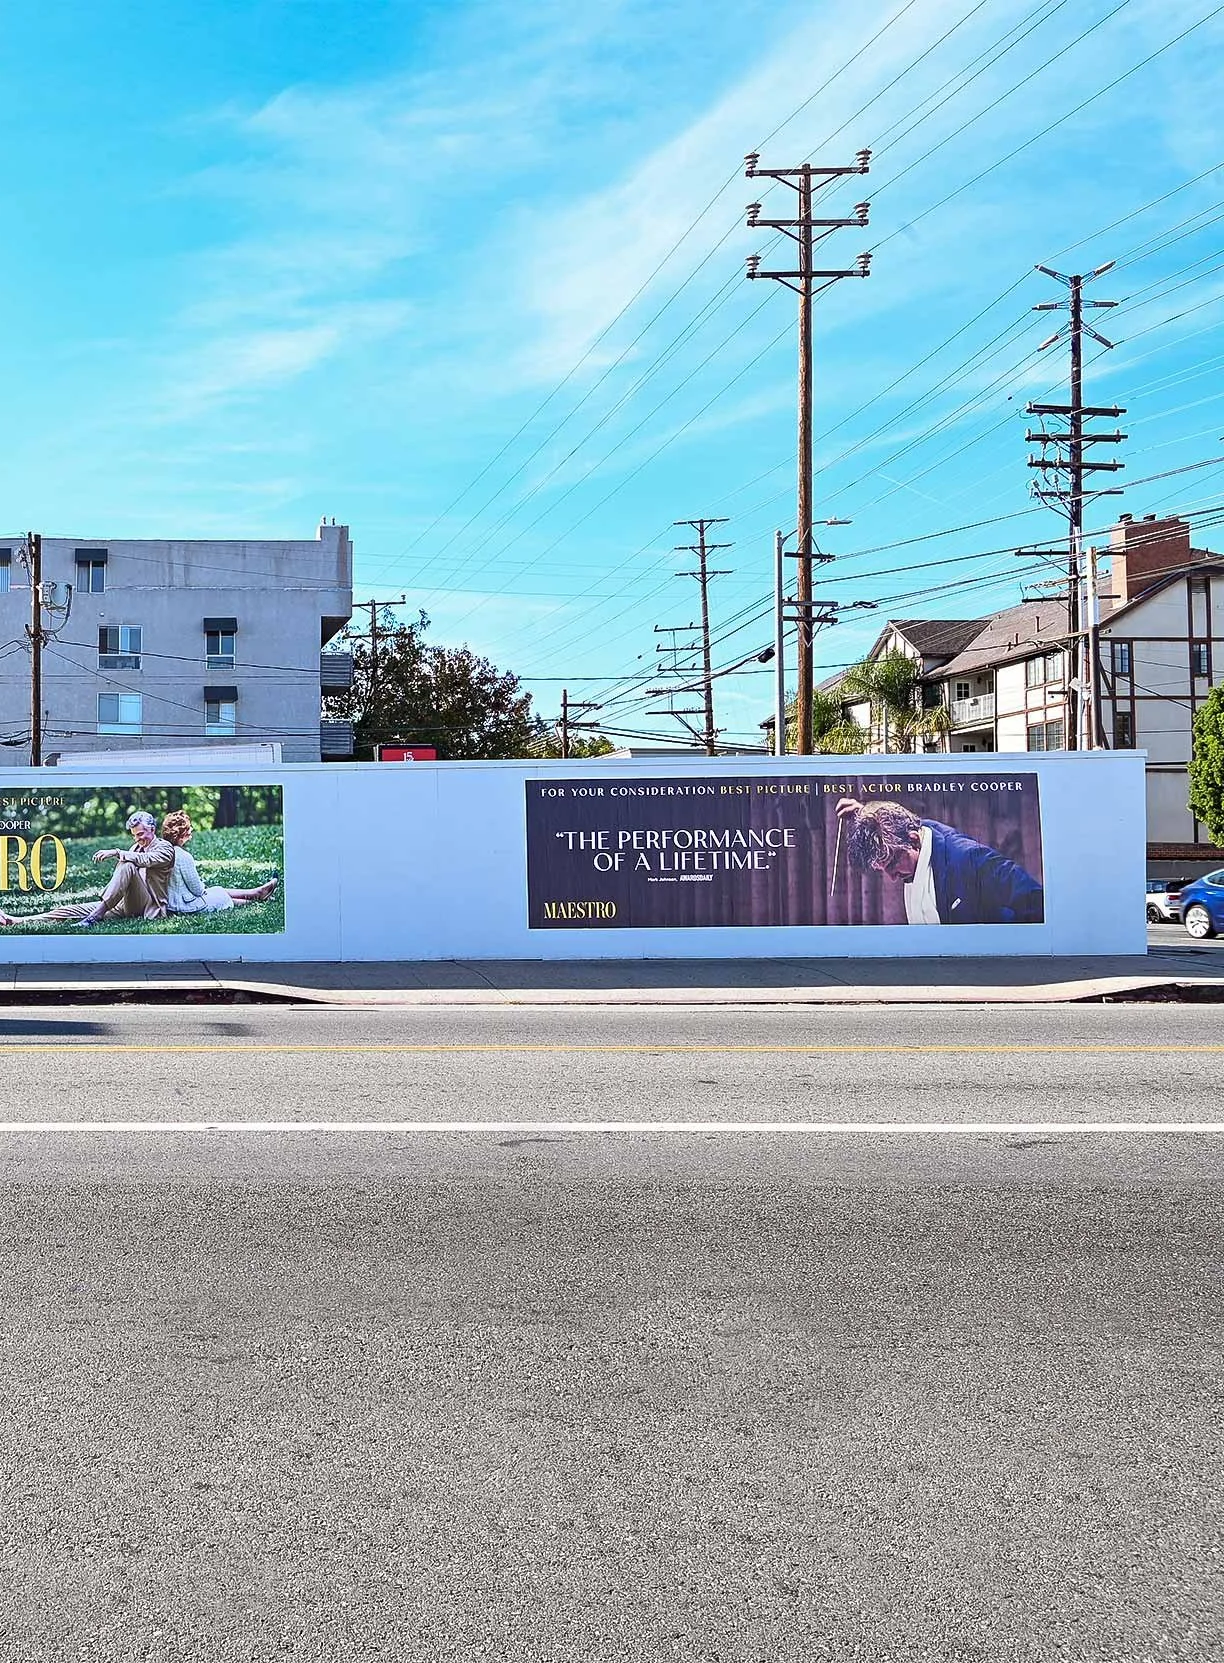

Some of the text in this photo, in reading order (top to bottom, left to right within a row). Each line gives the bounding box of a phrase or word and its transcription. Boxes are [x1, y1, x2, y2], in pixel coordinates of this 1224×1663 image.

[541, 782, 1023, 797] FOR YOUR CONSIDERATION BEST PICTURE BEST ACTOR BRADLEY COOPER
[555, 829, 796, 850] “THE PERFORMANCE
[593, 852, 626, 872] OF
[634, 852, 652, 871] A
[544, 901, 617, 919] MAESTRO
